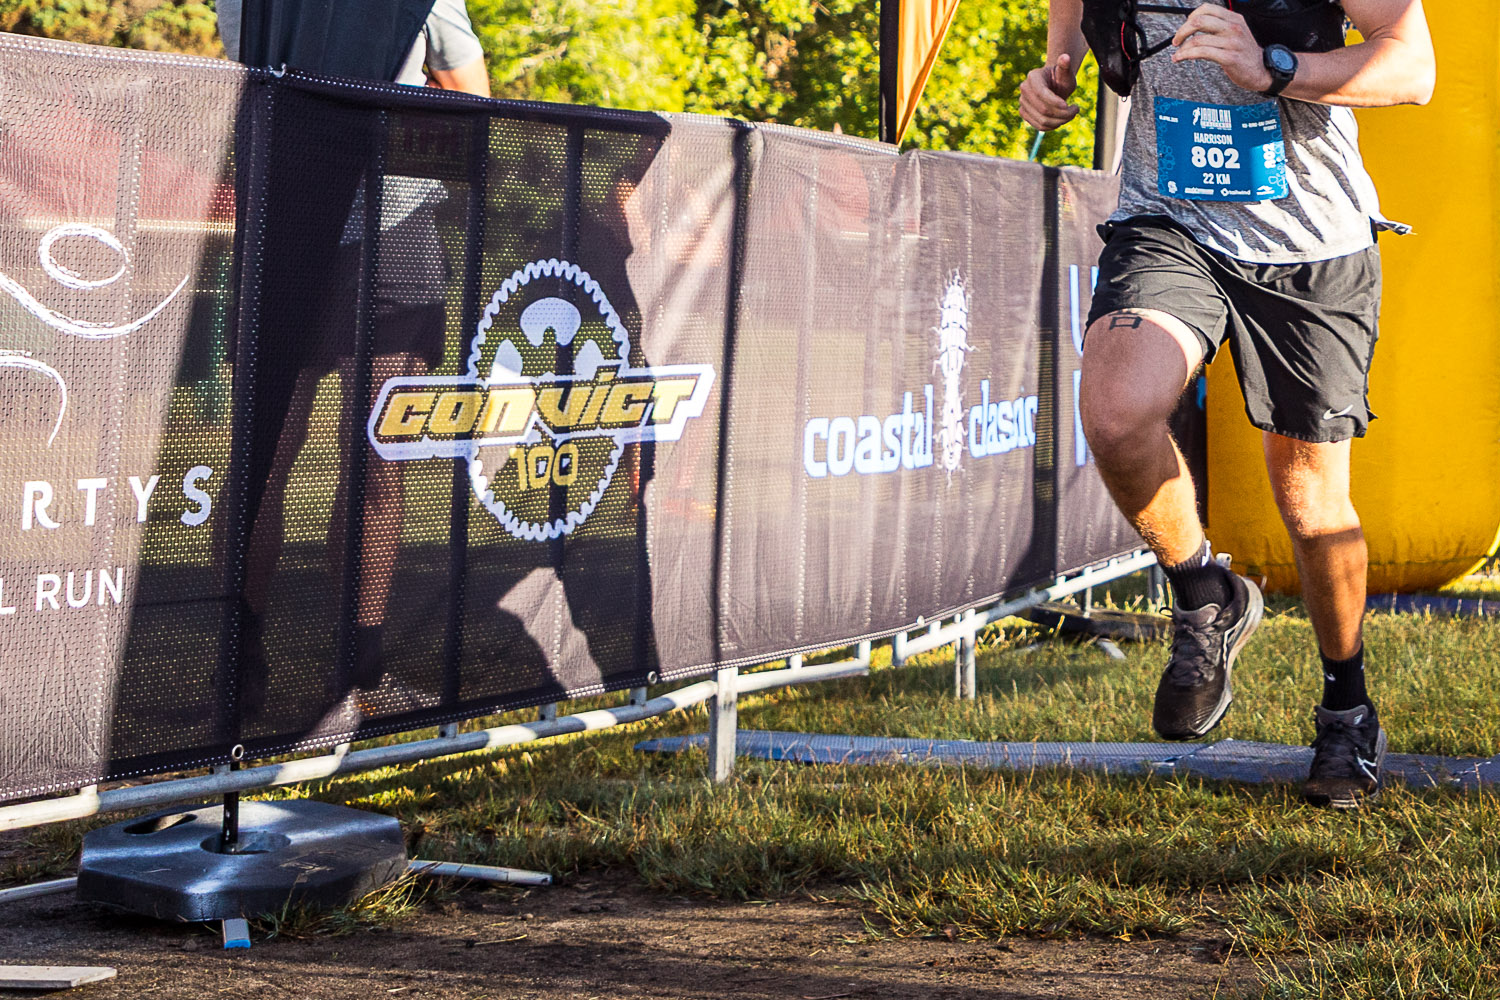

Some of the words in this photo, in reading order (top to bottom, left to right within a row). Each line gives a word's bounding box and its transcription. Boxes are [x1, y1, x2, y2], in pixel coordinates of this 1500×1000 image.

[1193, 132, 1233, 145] HARRISON
[1191, 145, 1241, 169] 802
[1202, 172, 1215, 185] 22
[1216, 173, 1231, 185] KM
[803, 384, 934, 478] coastal
[508, 443, 579, 490] 100
[35, 567, 124, 612] RUN
